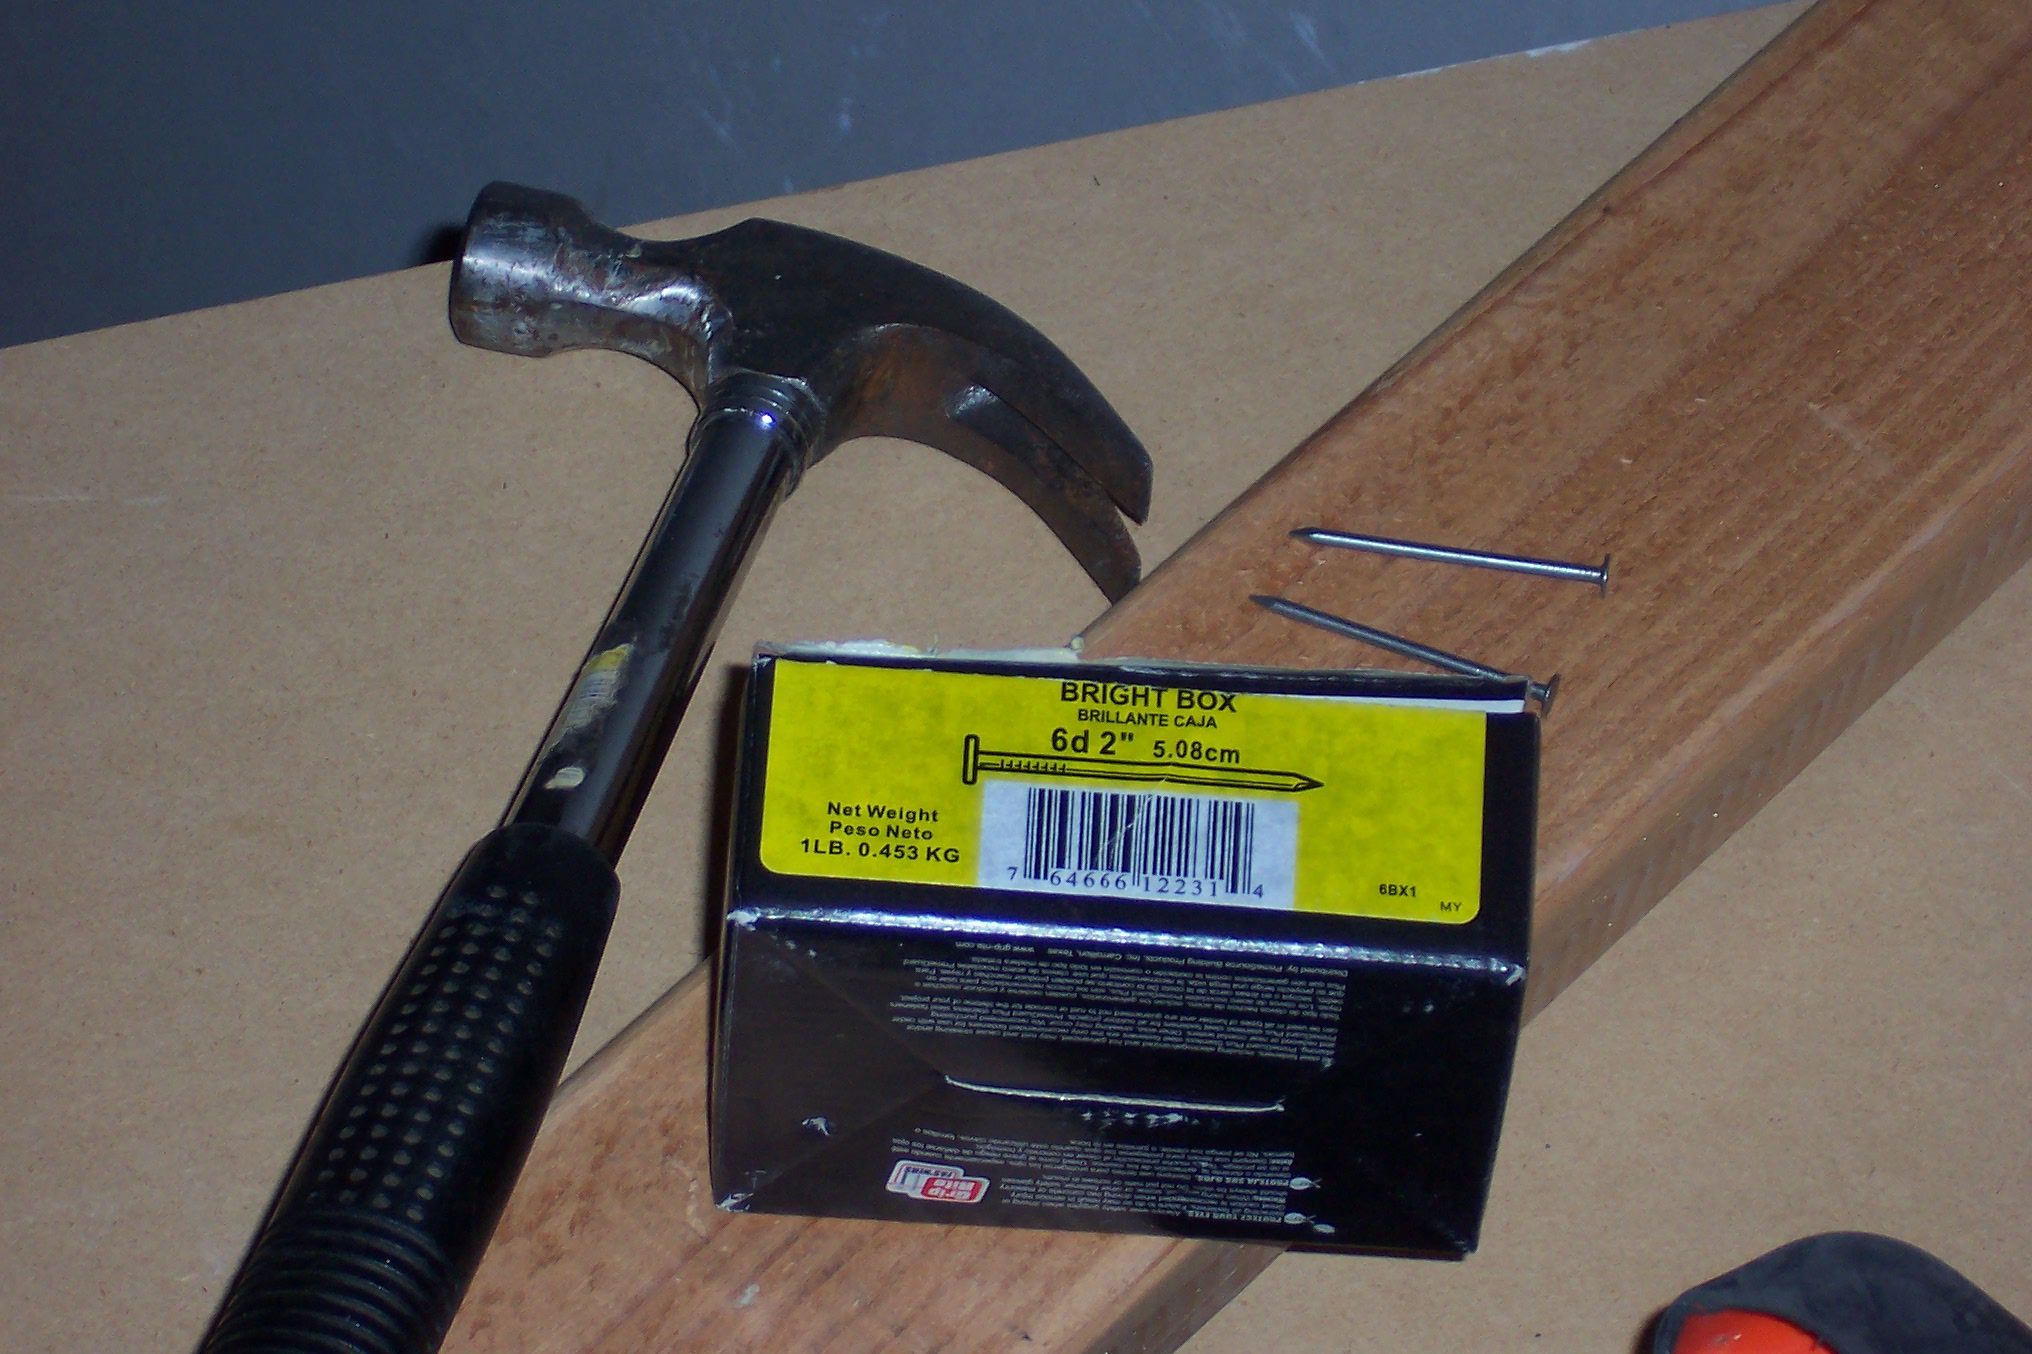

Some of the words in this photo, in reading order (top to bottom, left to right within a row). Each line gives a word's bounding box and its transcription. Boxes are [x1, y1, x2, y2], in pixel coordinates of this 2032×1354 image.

[1060, 681, 1168, 708] BRIGHT
[1176, 688, 1237, 713] BOX
[1077, 708, 1169, 727] BRILLANTE
[1173, 714, 1218, 729] CAJA
[1051, 727, 1090, 754] 6d
[1099, 731, 1134, 756] 2"
[1153, 739, 1240, 764] 5.08cm
[827, 801, 861, 817] Net
[866, 803, 939, 823] Weight
[829, 820, 880, 838] Peso
[886, 824, 934, 841] Neto
[801, 838, 851, 856] 1LB.
[858, 842, 919, 861] 0.453
[925, 846, 960, 863] KG
[1007, 865, 1019, 881] 7
[1050, 869, 1127, 890] 64666
[1143, 872, 1217, 897] 12231
[1252, 883, 1265, 899] 4
[1379, 883, 1417, 898] 6BX1
[1439, 900, 1463, 912] MY
